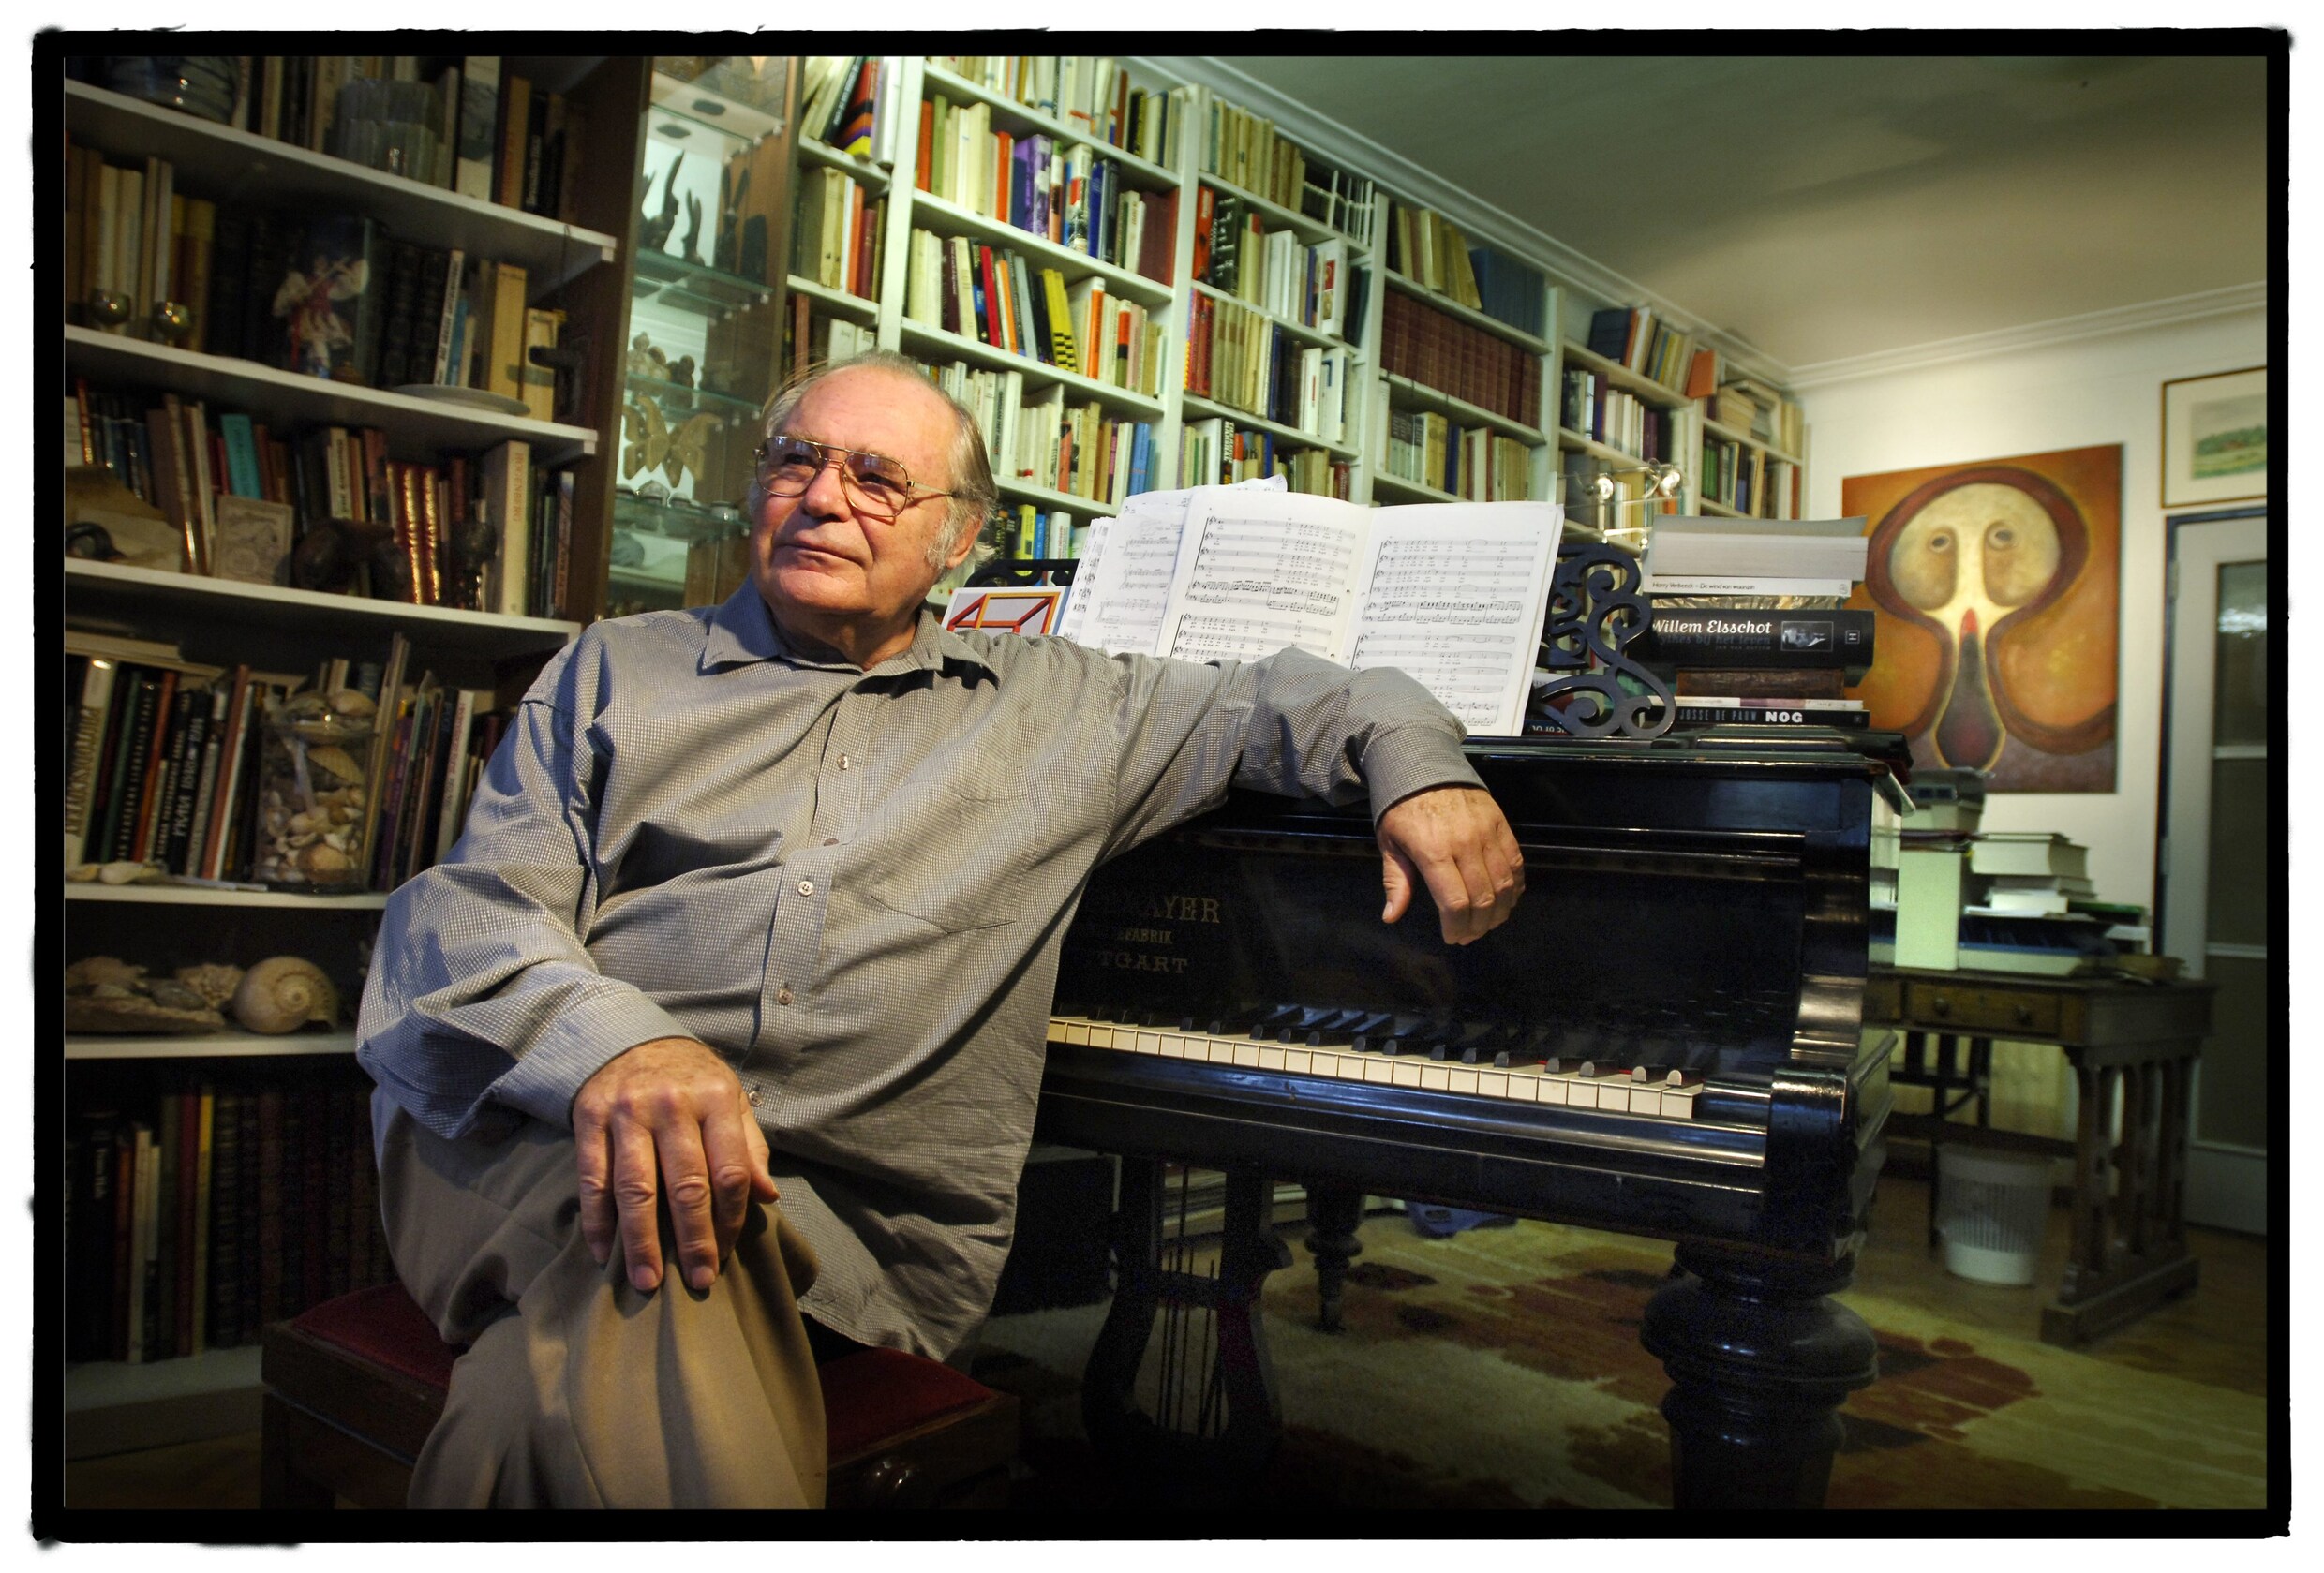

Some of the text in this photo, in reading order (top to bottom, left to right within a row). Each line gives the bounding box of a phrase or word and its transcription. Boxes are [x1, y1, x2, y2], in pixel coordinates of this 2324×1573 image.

[1652, 619, 1772, 634] Willem Elsschot
[1715, 633, 1734, 645] het
[1678, 707, 1803, 723] JOSSE DE PAUW NOG
[1125, 928, 1173, 944] FABRIK
[1096, 949, 1189, 974] TGART
